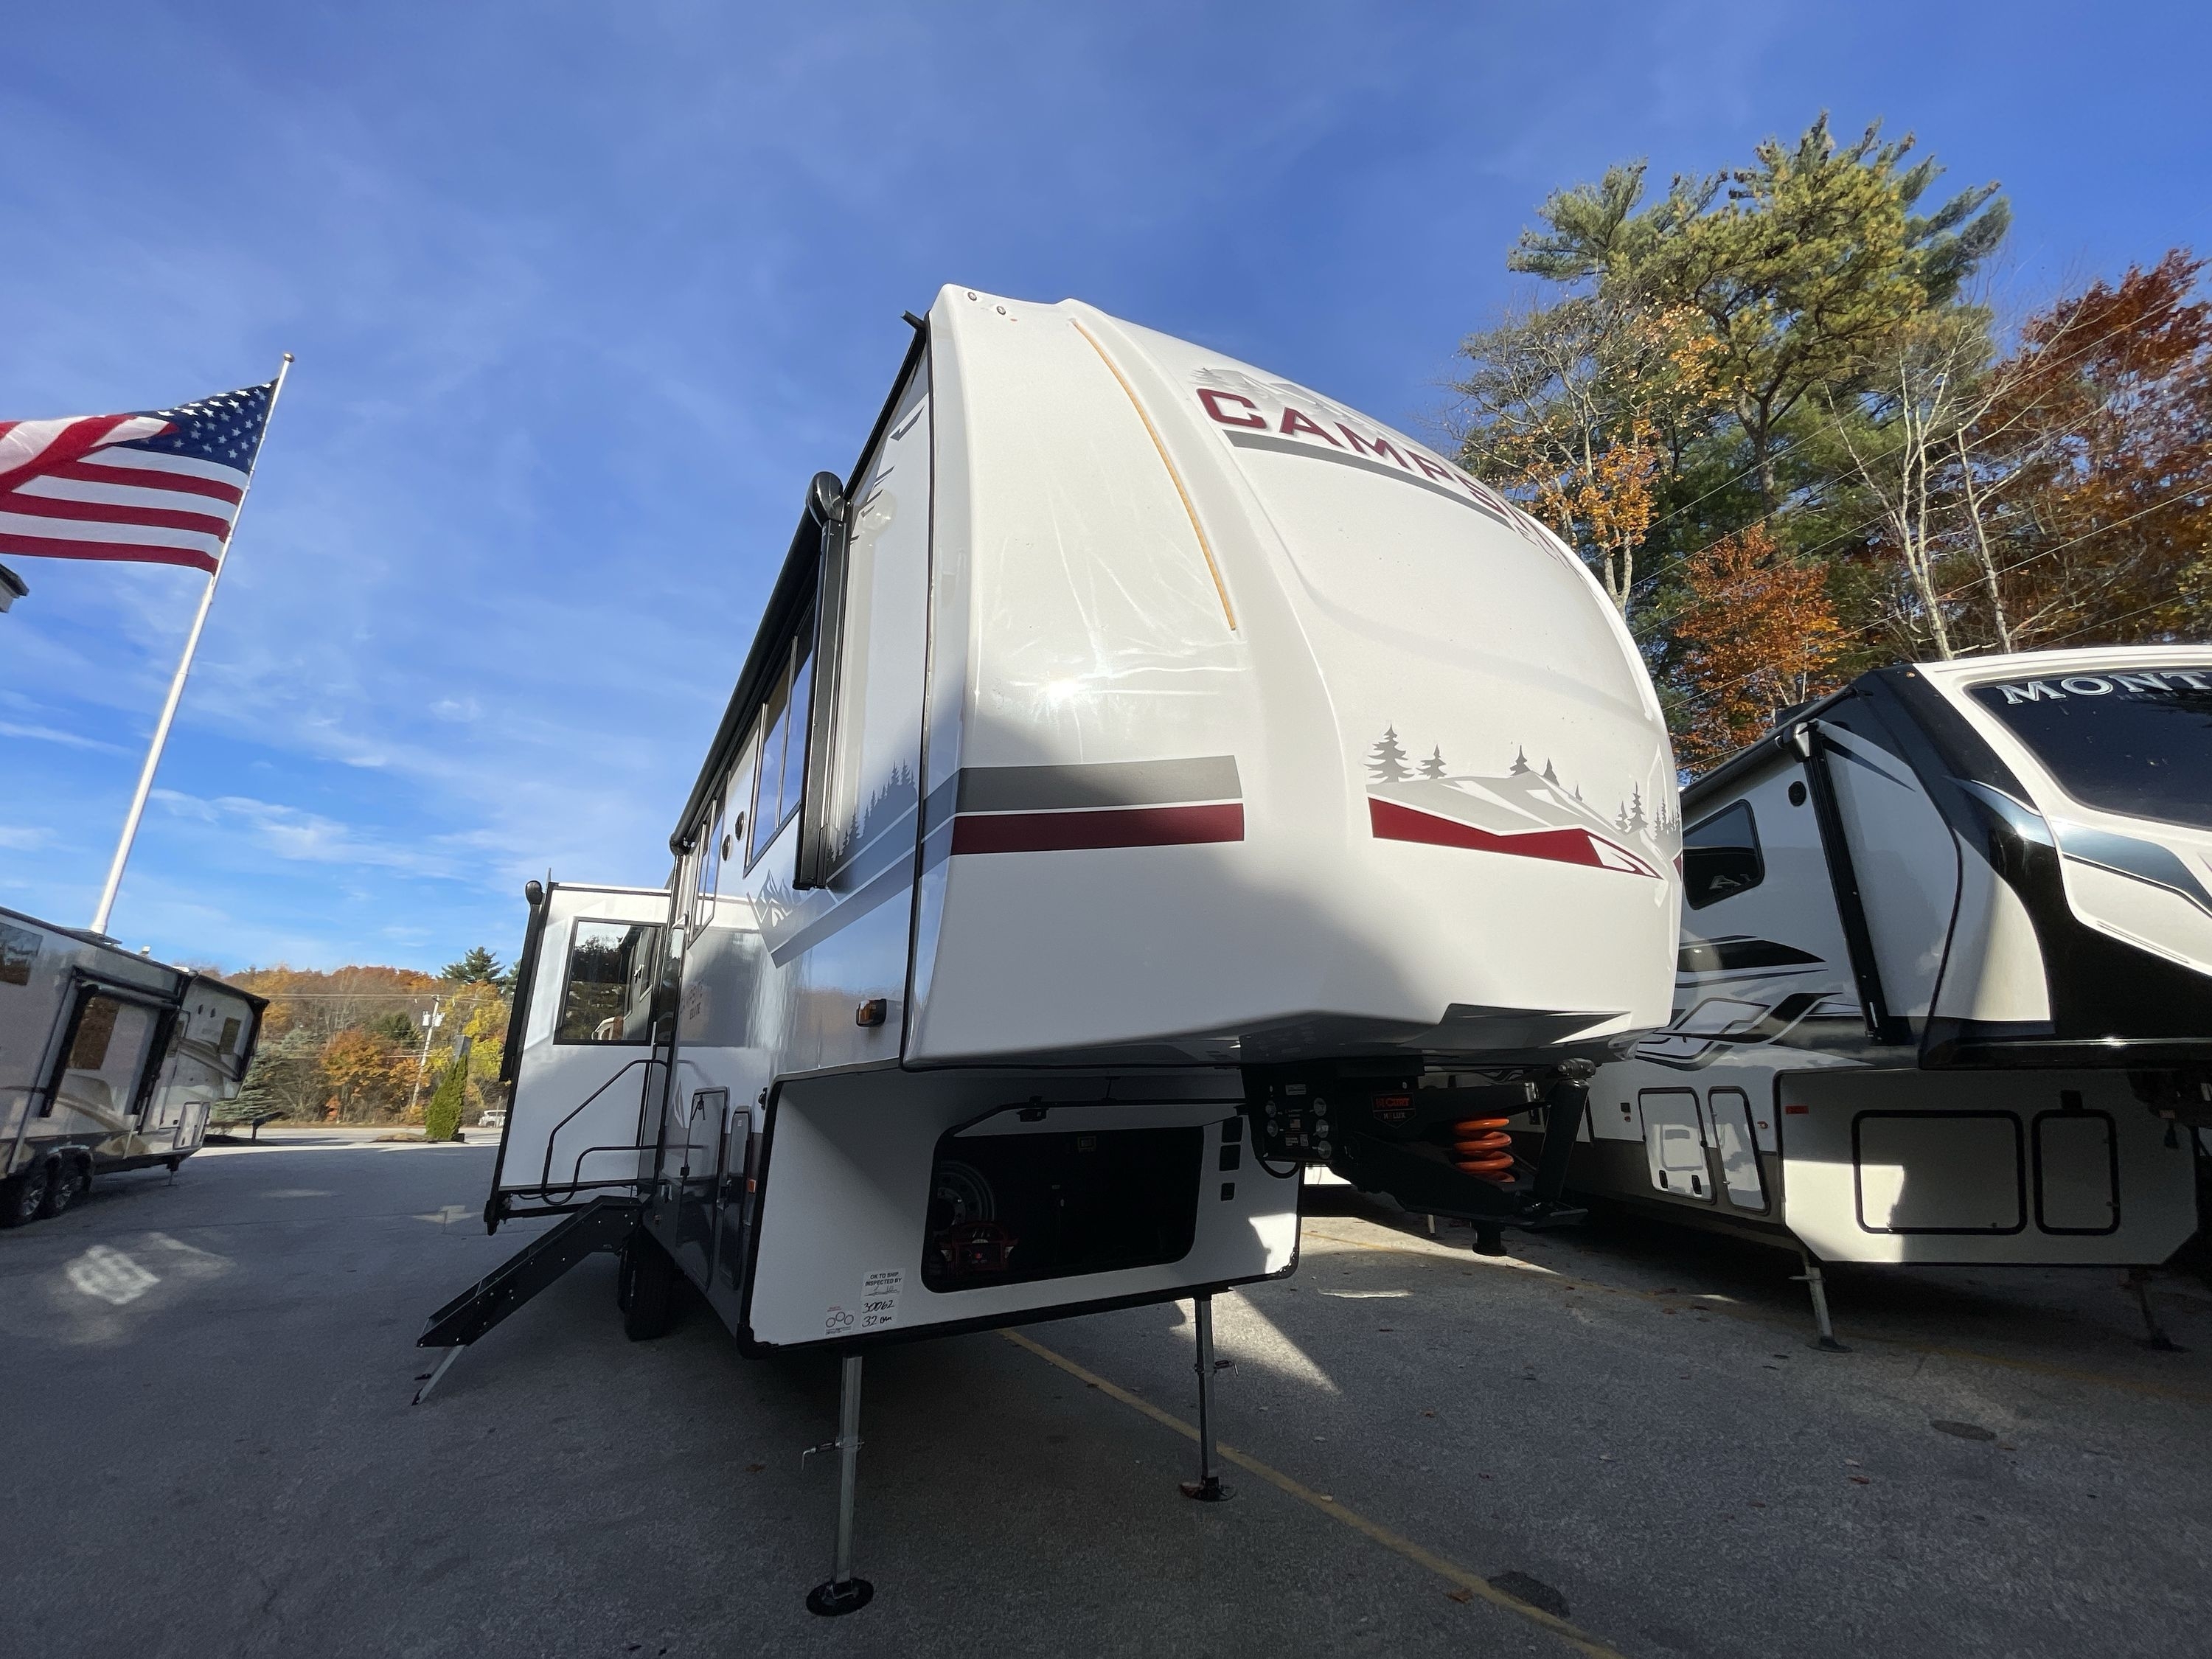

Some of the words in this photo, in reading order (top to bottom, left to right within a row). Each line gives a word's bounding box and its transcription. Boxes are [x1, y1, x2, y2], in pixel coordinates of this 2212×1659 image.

[1995, 672, 2212, 705] MONT
[862, 1300, 894, 1314] 30062
[862, 1315, 877, 1327] 32
